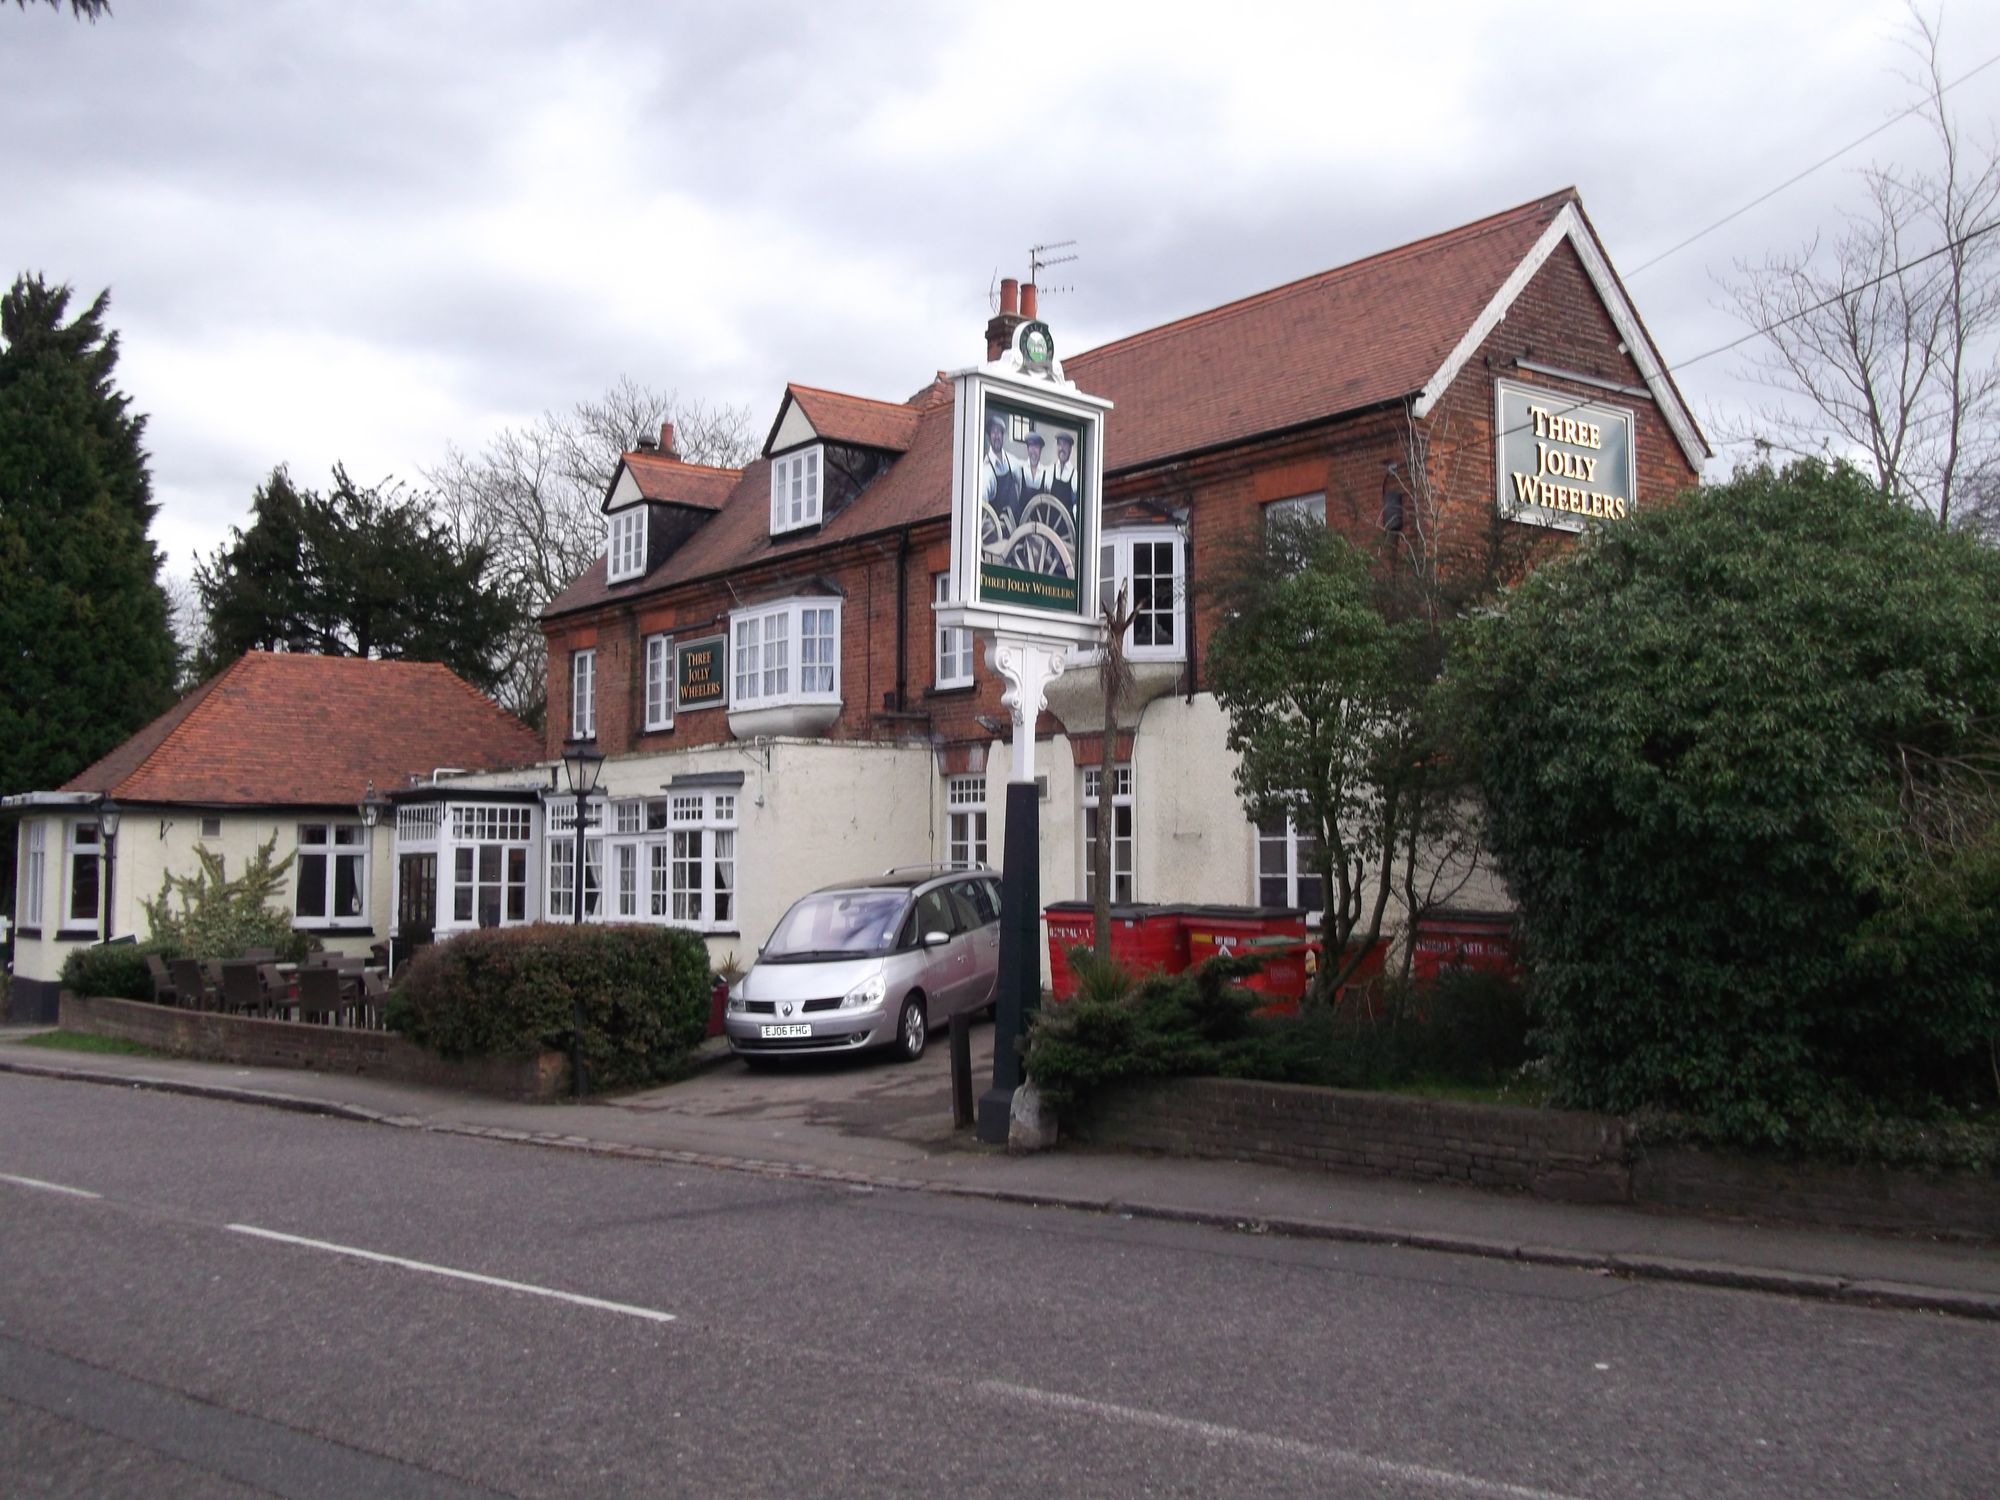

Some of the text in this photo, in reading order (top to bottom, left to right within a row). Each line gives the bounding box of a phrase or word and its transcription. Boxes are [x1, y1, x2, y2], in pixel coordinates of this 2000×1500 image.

[1529, 405, 1601, 449] THREE
[1537, 442, 1597, 482] JOLLY
[1513, 472, 1626, 520] WHEELERS
[980, 573, 1075, 599] THREE JOLLY WHEELERS
[686, 650, 712, 667] THREE
[688, 667, 710, 684] JOLLY
[680, 681, 720, 699] WHEELERS
[765, 1025, 808, 1037] EJ06 FHG
